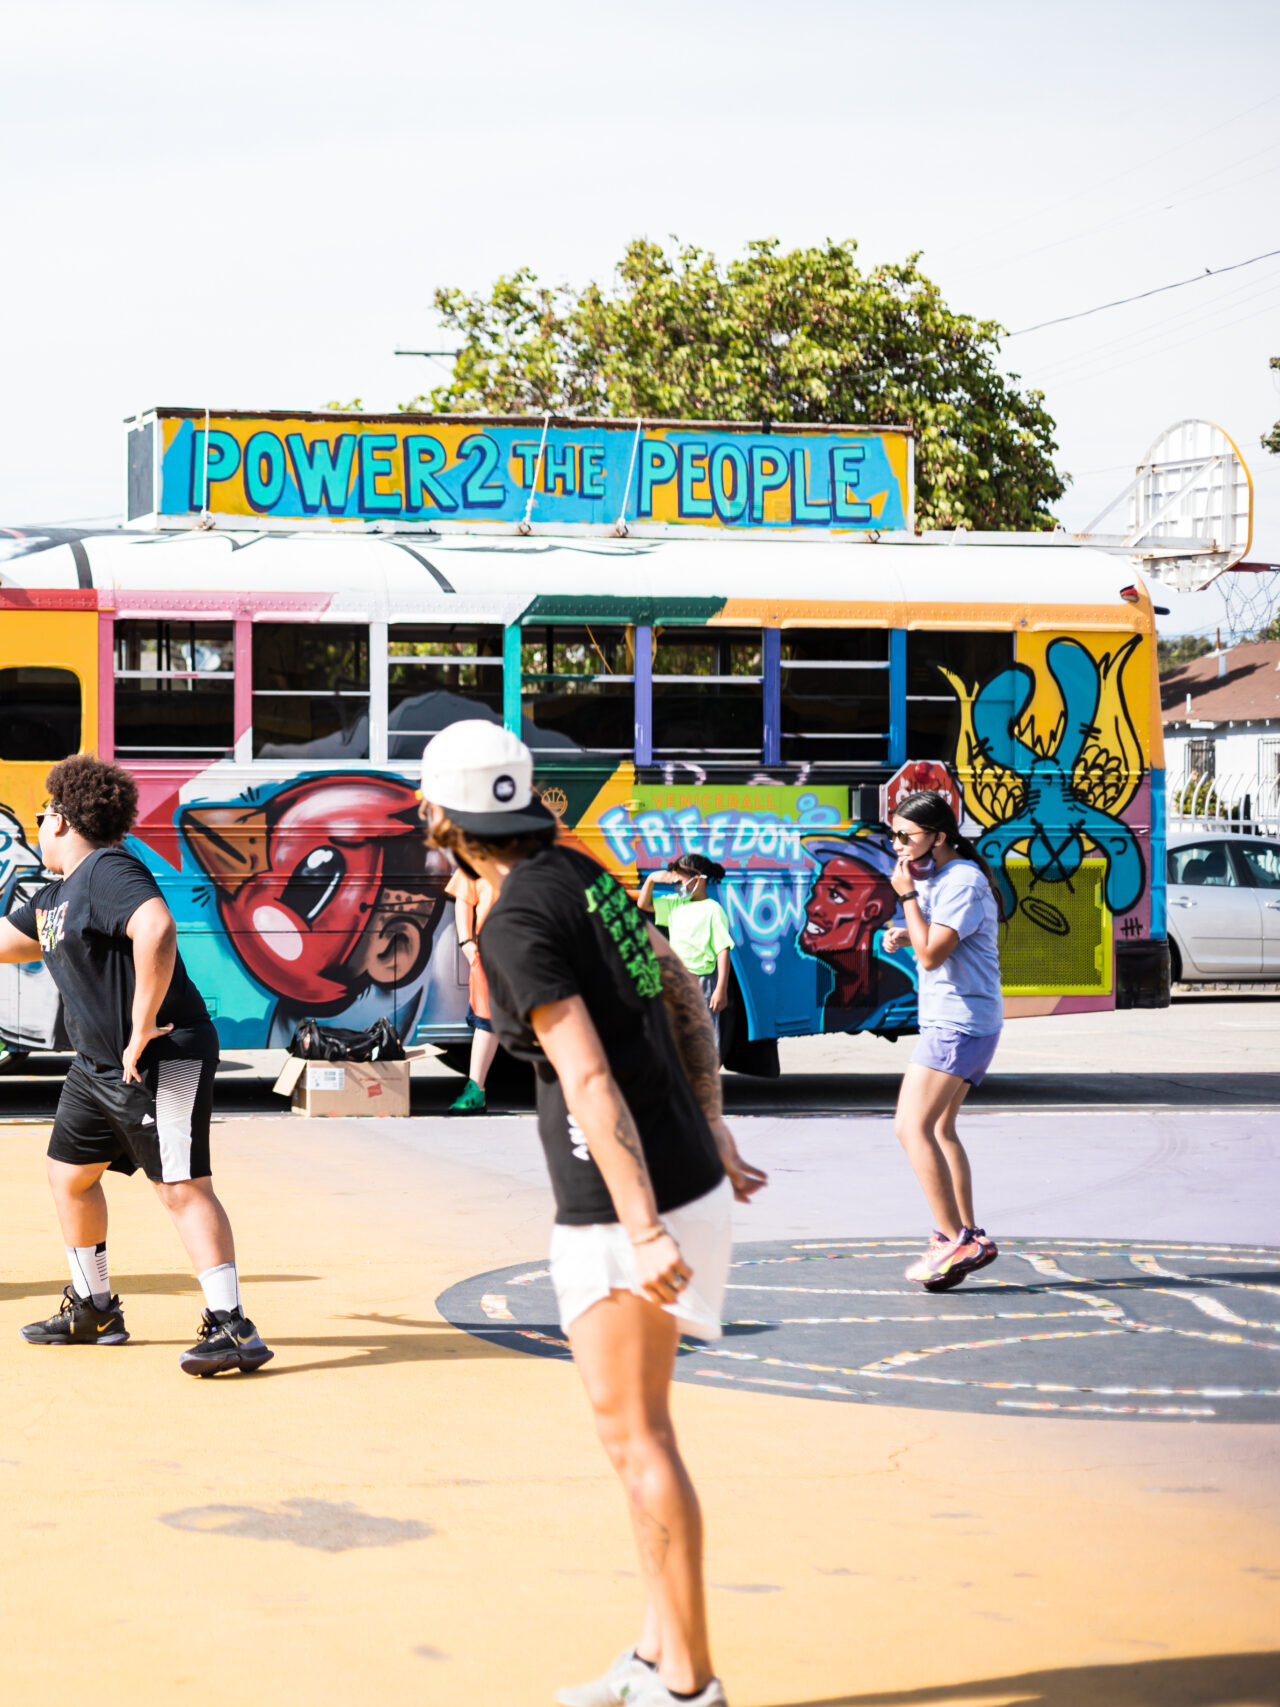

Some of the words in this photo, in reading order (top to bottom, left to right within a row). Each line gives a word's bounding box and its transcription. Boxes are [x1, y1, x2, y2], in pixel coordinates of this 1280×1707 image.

[513, 443, 606, 499] THE
[637, 439, 872, 524] PEOPLE
[652, 793, 777, 810] VENICEBALL
[598, 806, 808, 864] FREEDOM
[720, 868, 809, 942] NOW
